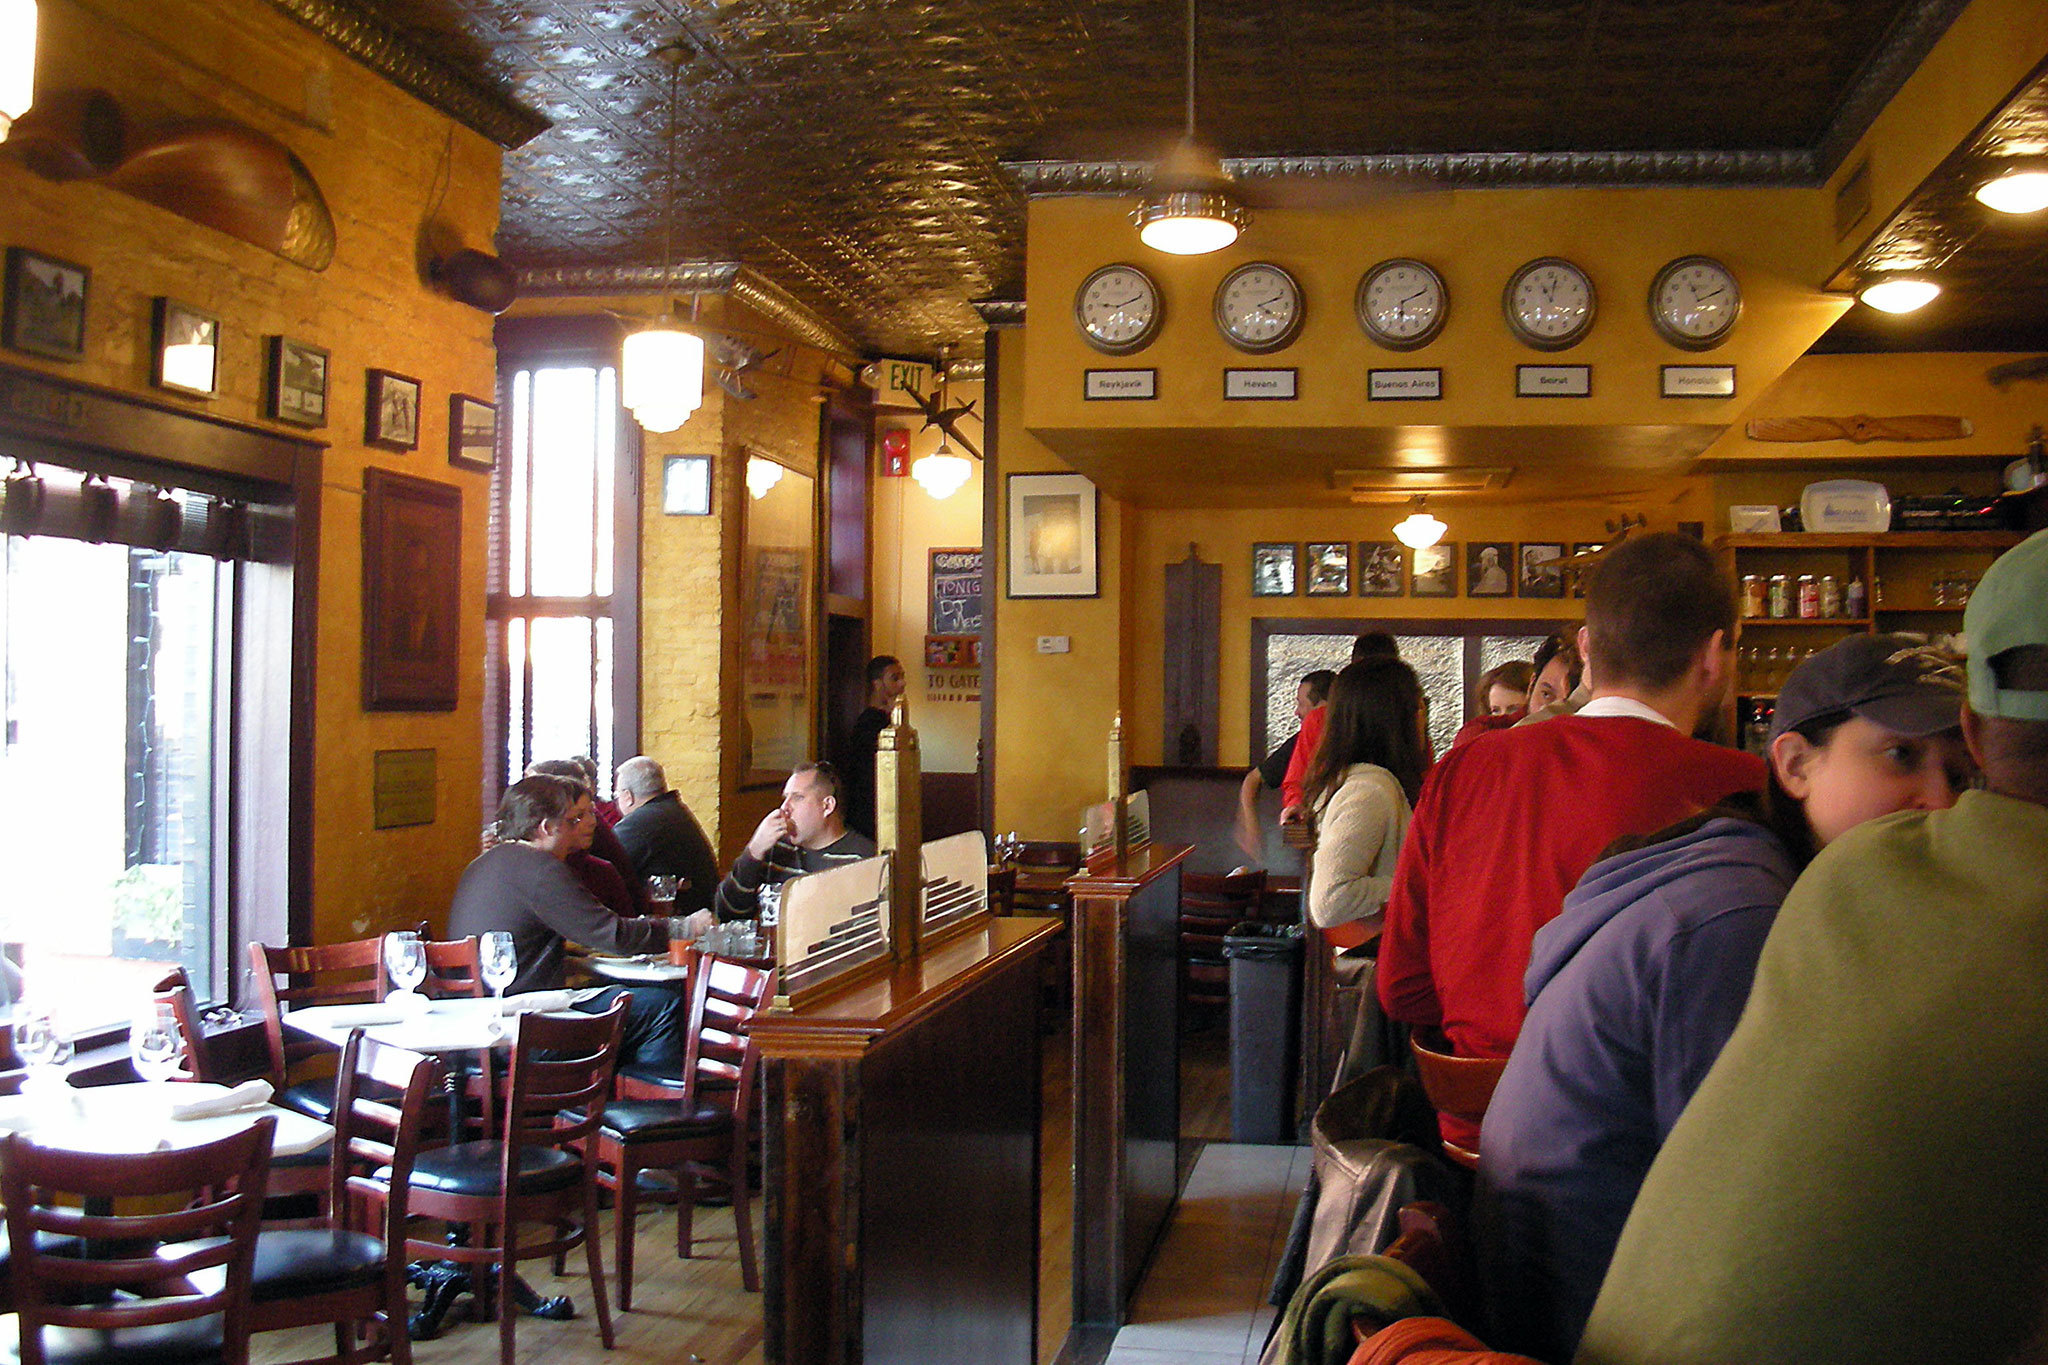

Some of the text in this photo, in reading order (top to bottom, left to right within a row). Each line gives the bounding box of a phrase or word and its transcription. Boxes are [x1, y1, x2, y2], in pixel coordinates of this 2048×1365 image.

[891, 364, 924, 392] EXIT
[1539, 376, 1568, 384] Beirut
[1099, 379, 1142, 390] Reykjavik
[1243, 379, 1278, 388] Havana
[1374, 379, 1436, 389] Buenos Aires
[927, 674, 944, 688] TO
